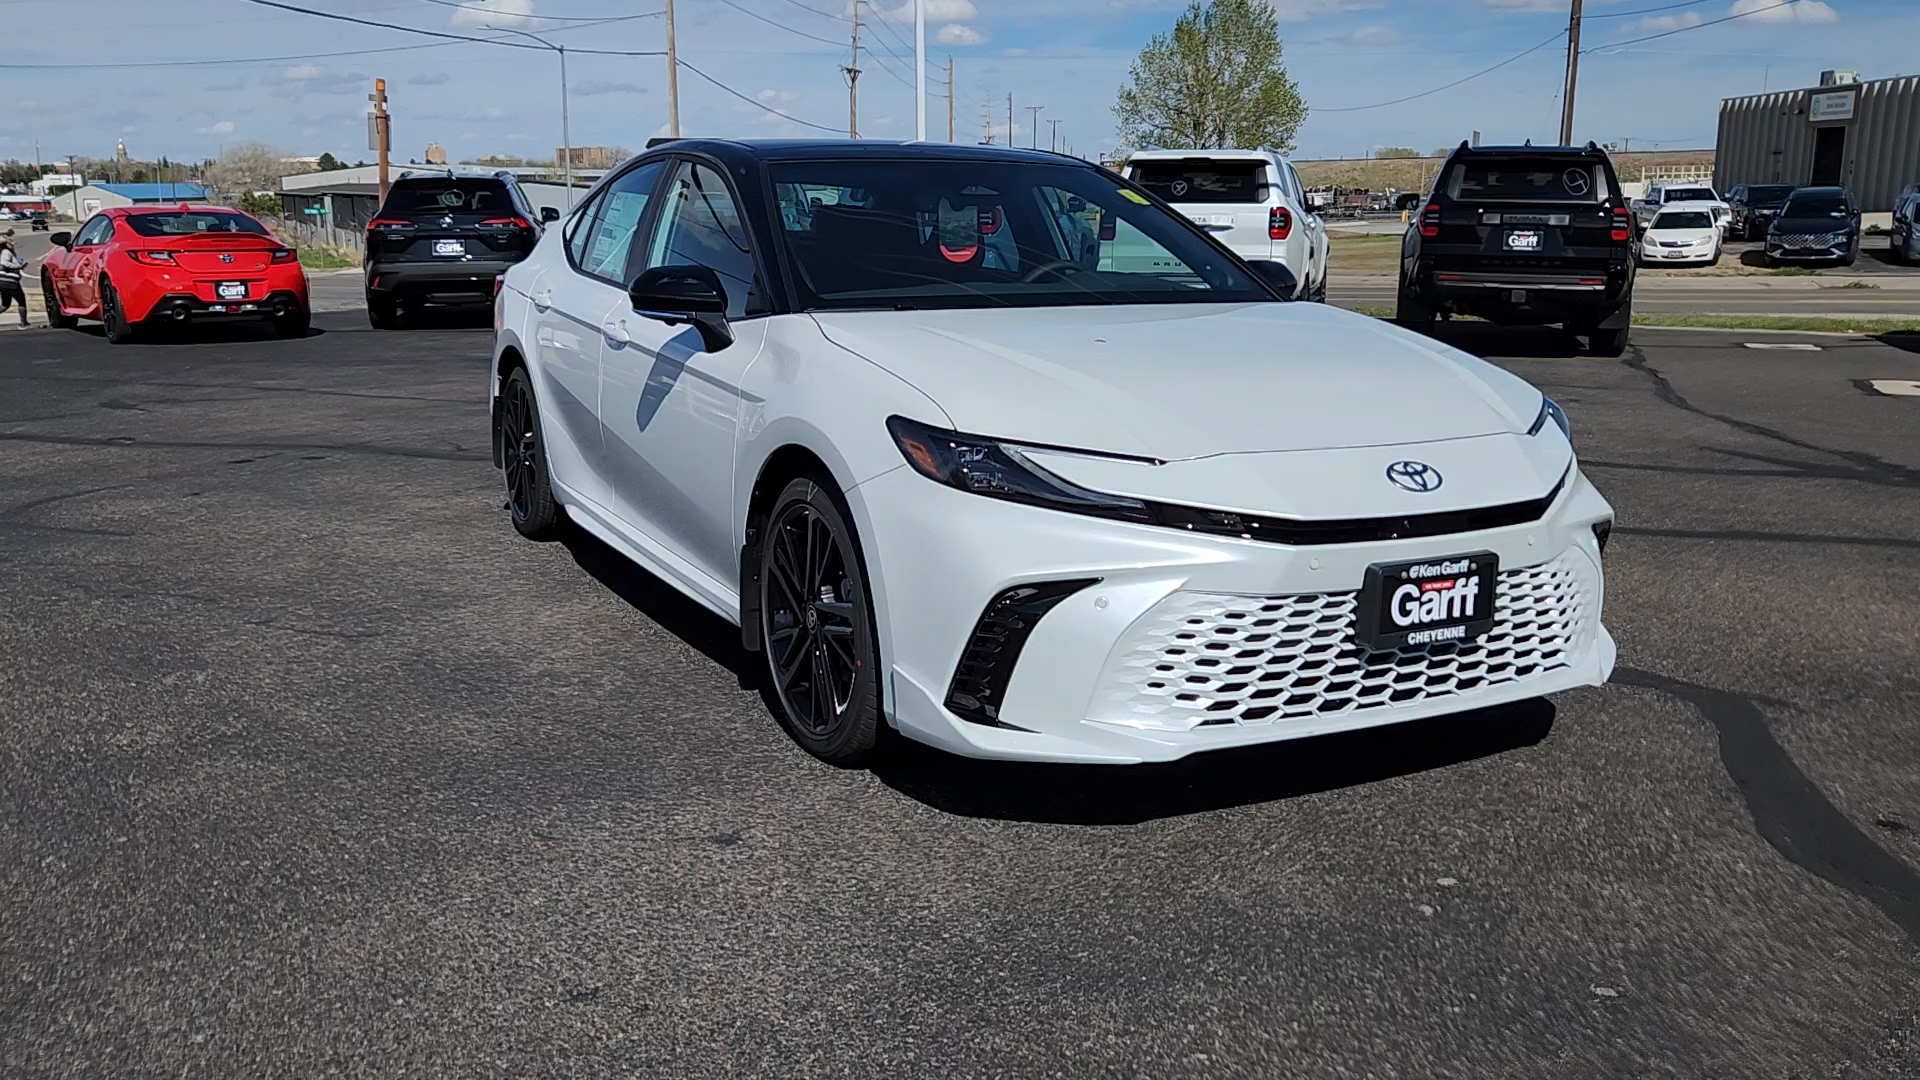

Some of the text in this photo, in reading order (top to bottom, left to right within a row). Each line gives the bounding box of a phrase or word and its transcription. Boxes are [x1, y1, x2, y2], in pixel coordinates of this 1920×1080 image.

[1508, 235, 1539, 247] Garff
[218, 285, 246, 296] Garff
[1419, 559, 1470, 578] Ken Garff
[1390, 576, 1480, 627] Garff
[1407, 625, 1466, 645] CHEYENNE
